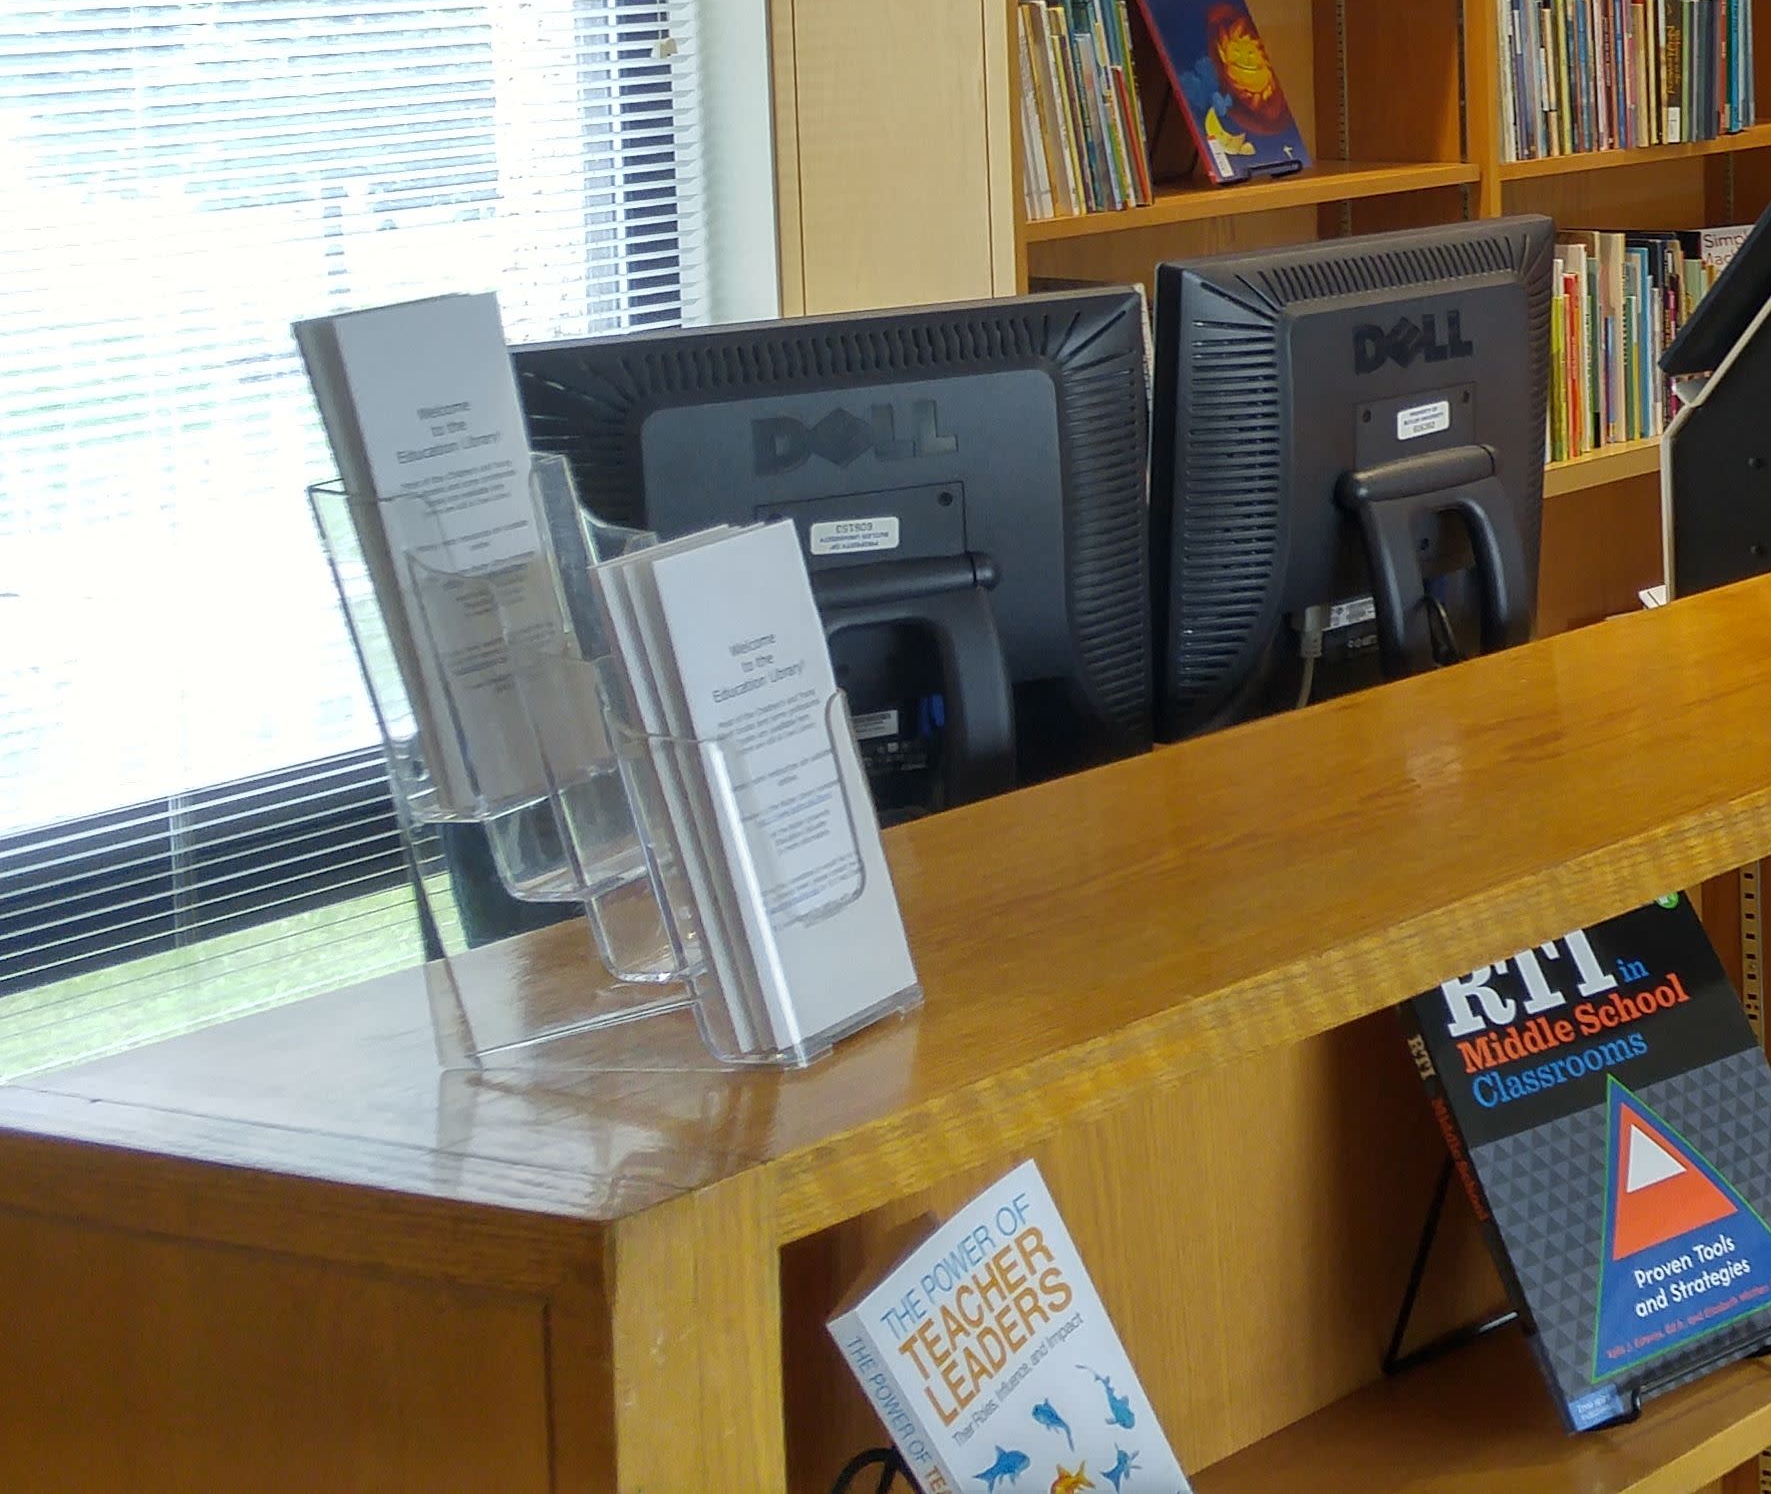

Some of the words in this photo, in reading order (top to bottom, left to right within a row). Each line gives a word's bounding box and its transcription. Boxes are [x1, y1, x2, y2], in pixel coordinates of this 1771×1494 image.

[1703, 233, 1747, 249] Simp
[1352, 309, 1474, 376] DELL
[416, 401, 470, 420] Welcome
[431, 426, 444, 437] to
[447, 421, 467, 433] the
[750, 399, 958, 476] DELL
[396, 442, 460, 464] Education
[728, 633, 777, 657] Welcome
[741, 661, 754, 673] to
[755, 654, 775, 668] the
[711, 676, 768, 703] Education
[1440, 928, 1618, 1037] RTI
[1616, 958, 1650, 984] in
[1456, 1016, 1577, 1074] Middle
[1574, 972, 1691, 1037] School
[1407, 1033, 1437, 1082] RTI
[1472, 1032, 1650, 1108] Classrooms
[880, 1286, 928, 1341] THE
[921, 1223, 998, 1304] POWER
[995, 1193, 1032, 1238] OF
[1633, 1255, 1694, 1289] Proven
[1692, 1233, 1737, 1264] Tools
[1635, 1285, 1670, 1318] and
[1668, 1257, 1752, 1303] Strategies
[898, 1226, 1056, 1381] TEACHER
[924, 1266, 1074, 1428] LEADERS
[1029, 1343, 1050, 1367] and
[847, 1335, 876, 1375] THE
[868, 1372, 917, 1441] POWER
[907, 1439, 933, 1463] OF
